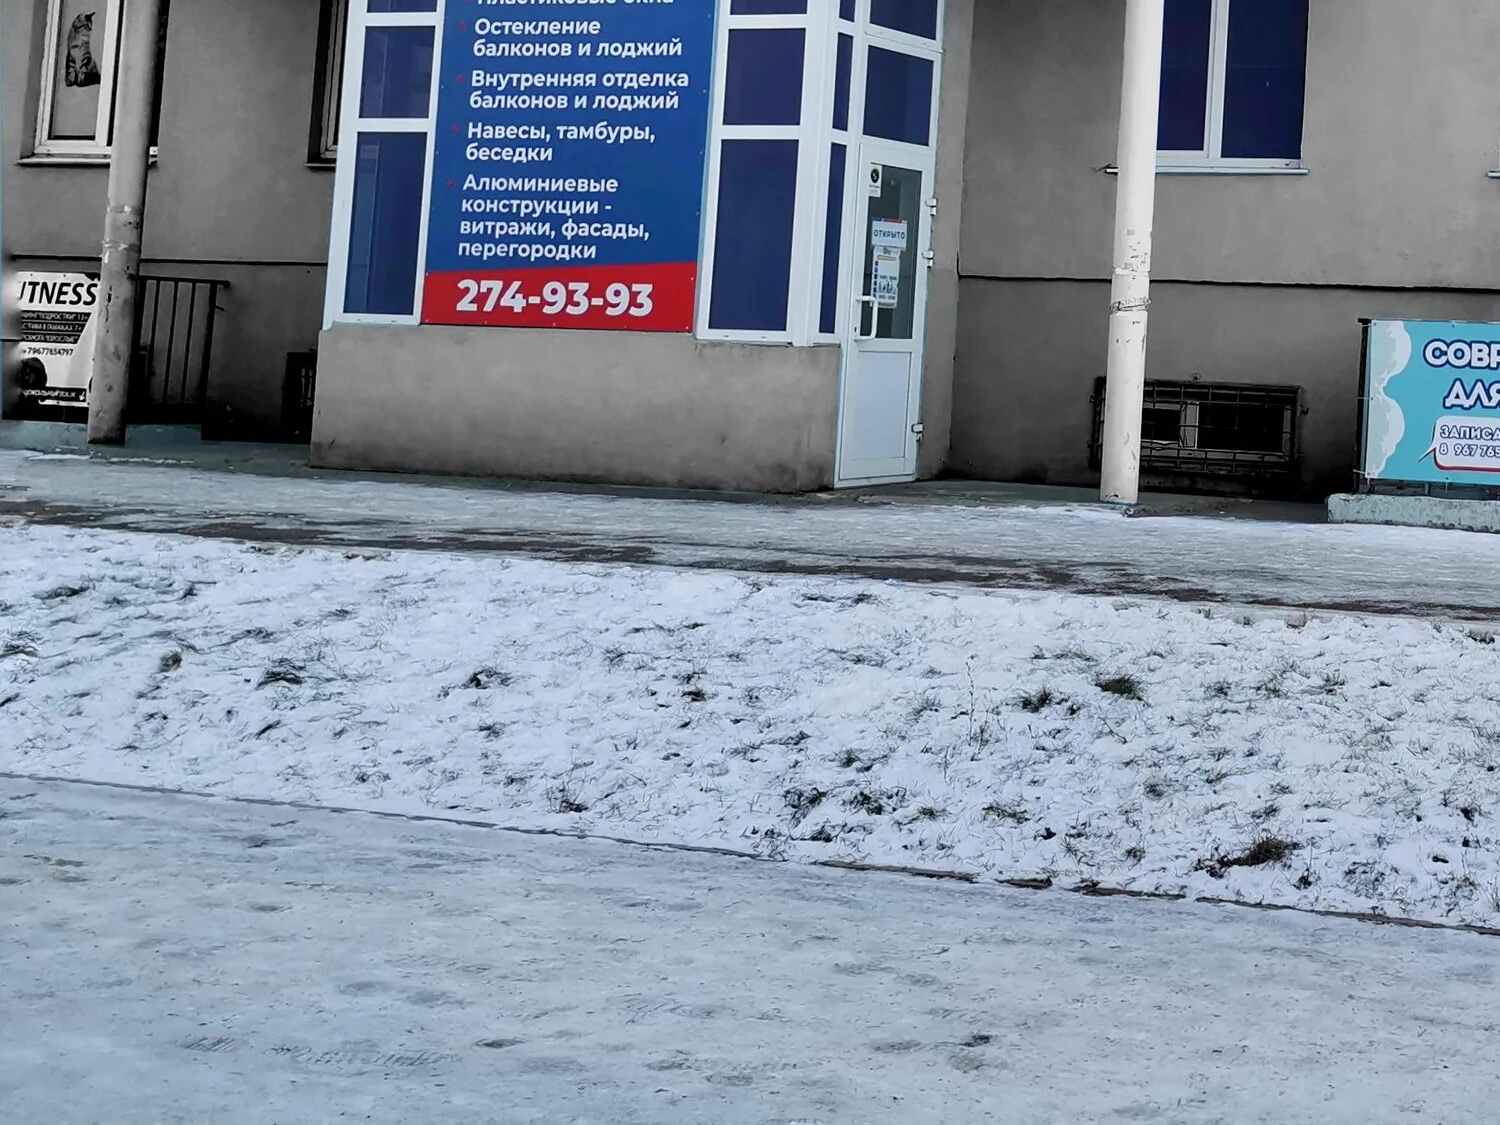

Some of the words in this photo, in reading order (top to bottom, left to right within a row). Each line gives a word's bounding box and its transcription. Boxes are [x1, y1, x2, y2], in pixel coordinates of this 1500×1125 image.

[474, 18, 601, 36] Остекление
[473, 39, 573, 57] балконов
[578, 42, 591, 56] и
[596, 38, 682, 58] лоджий
[471, 71, 597, 90] Внутренняя
[602, 73, 689, 89] отделка
[469, 91, 568, 109] балконов
[574, 95, 587, 108] и
[593, 91, 679, 111] лоджий
[468, 122, 551, 142] Навесы,
[556, 122, 656, 144] тамбуры,
[465, 142, 553, 163] беседки
[463, 174, 619, 193] Алюминиевые
[461, 197, 599, 218] конструкции
[460, 219, 556, 238] витражи,
[561, 219, 650, 241] фасады,
[873, 229, 906, 240] ОТКРЫТО
[458, 241, 597, 261] перегородки
[455, 279, 654, 317] 274-93-93
[1439, 443, 1448, 455] 8
[1454, 443, 1477, 457] 967
